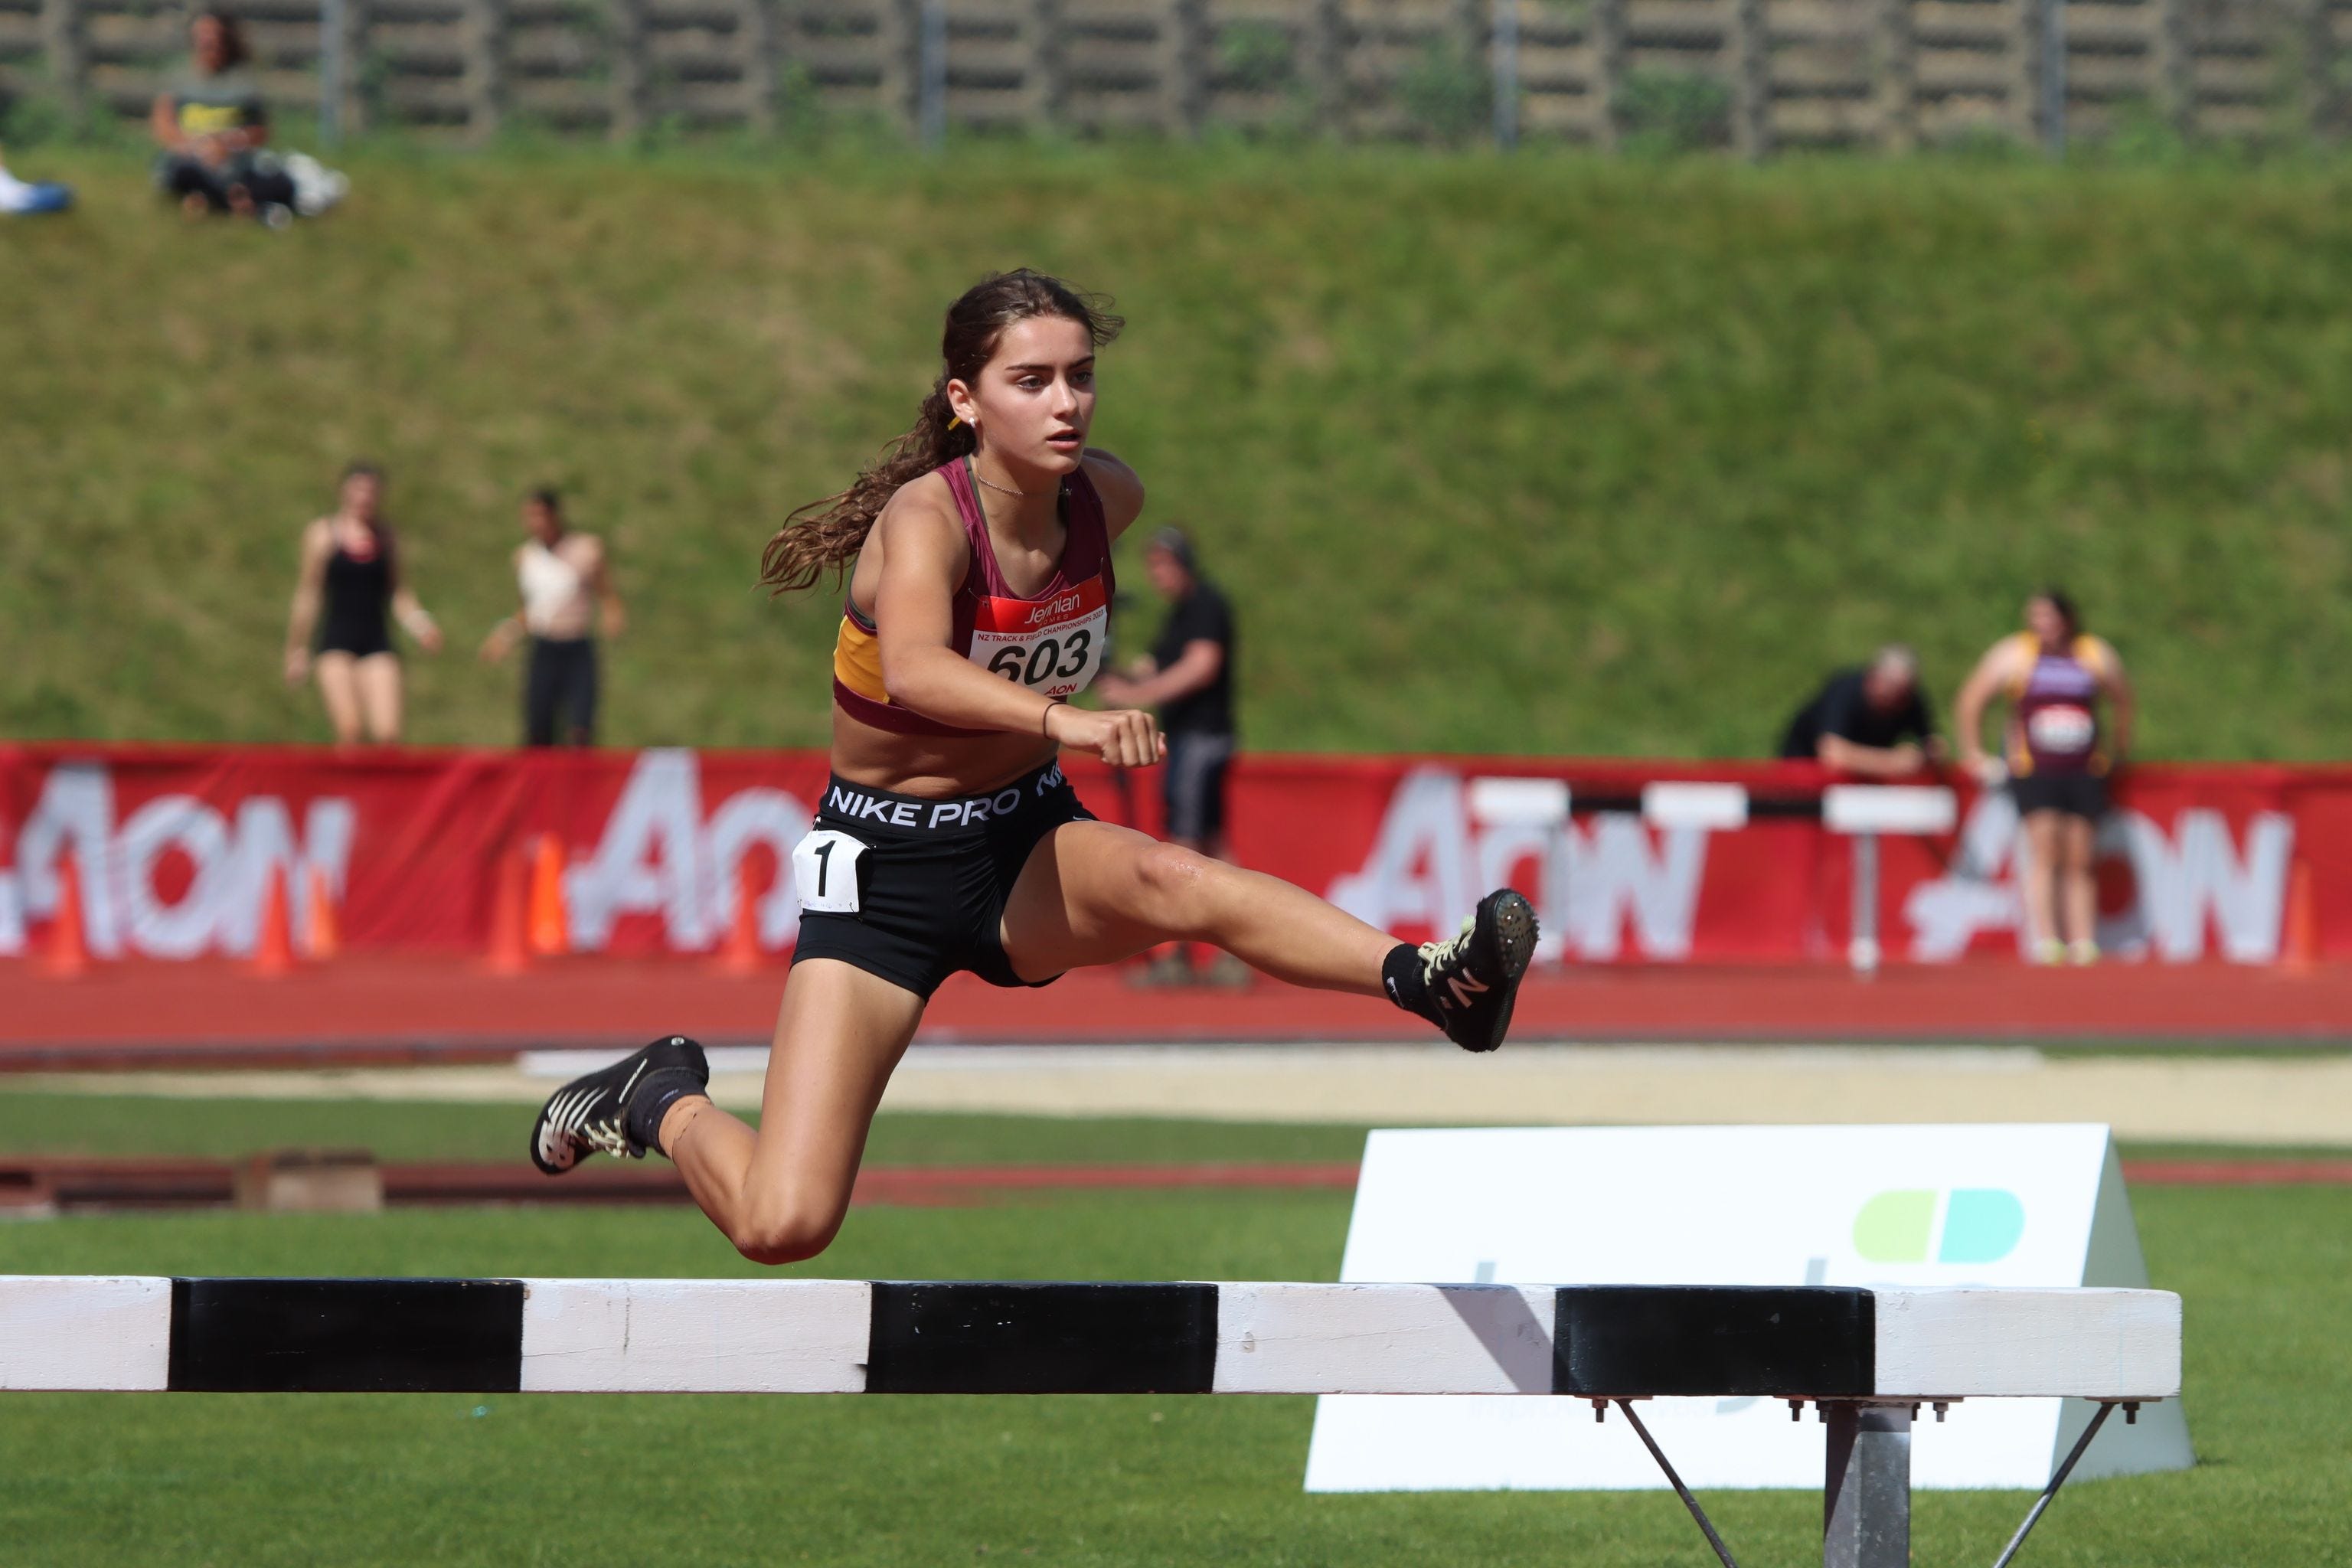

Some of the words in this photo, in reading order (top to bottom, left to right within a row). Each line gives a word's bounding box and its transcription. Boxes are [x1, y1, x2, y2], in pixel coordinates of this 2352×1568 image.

[978, 633, 990, 642] NZ
[1043, 617, 1092, 636] CHAMPIONSHIPS
[987, 629, 1092, 686] 603
[1044, 683, 1078, 696] AON
[828, 785, 922, 828] NIKE
[928, 788, 1021, 829] PRO
[565, 746, 821, 954] AO
[813, 839, 837, 897] 1
